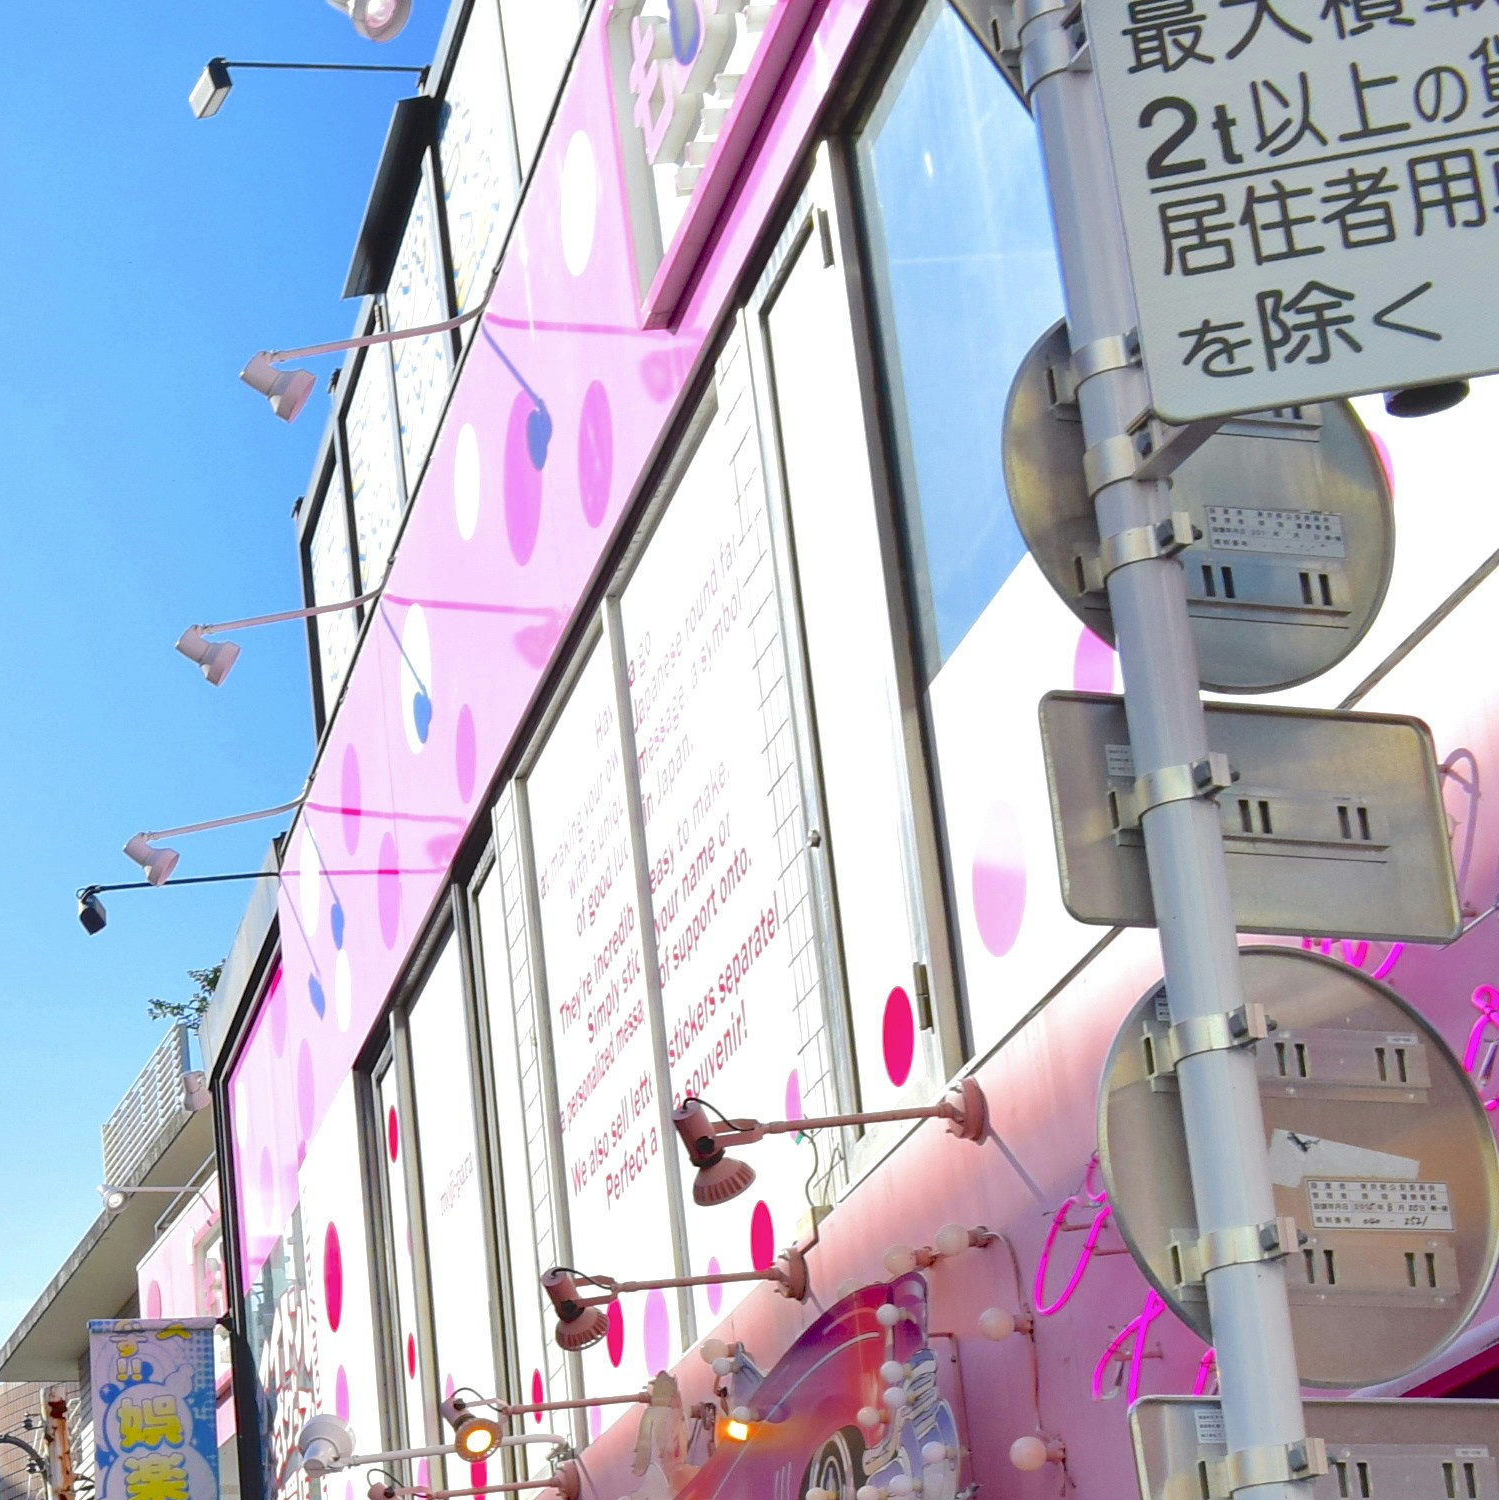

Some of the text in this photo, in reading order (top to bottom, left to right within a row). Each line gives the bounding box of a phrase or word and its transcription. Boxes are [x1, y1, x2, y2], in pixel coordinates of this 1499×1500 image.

[1158, 147, 1499, 276] 居住者用
[1178, 281, 1442, 377] を除く
[634, 632, 682, 734] Japanese
[685, 558, 718, 642] round
[701, 577, 742, 673] symbol
[559, 972, 593, 1034] They're
[593, 902, 635, 984] incredib
[649, 844, 674, 894] easy
[677, 817, 689, 852] to
[576, 898, 587, 937] of
[588, 856, 612, 926] good
[613, 837, 629, 877] luc
[588, 811, 731, 1044] Simply stic your name or
[566, 1037, 615, 1132] personalized
[616, 999, 646, 1054] messa
[660, 945, 670, 989] of
[673, 884, 718, 970] support
[719, 847, 752, 903] onto.
[571, 1157, 588, 1198] We
[589, 1131, 610, 1177] also
[611, 1095, 630, 1148] sell
[668, 987, 716, 1068] stickers
[718, 890, 780, 1004] separatel
[606, 1132, 648, 1210] Perfect
[685, 999, 748, 1100] souvenir!
